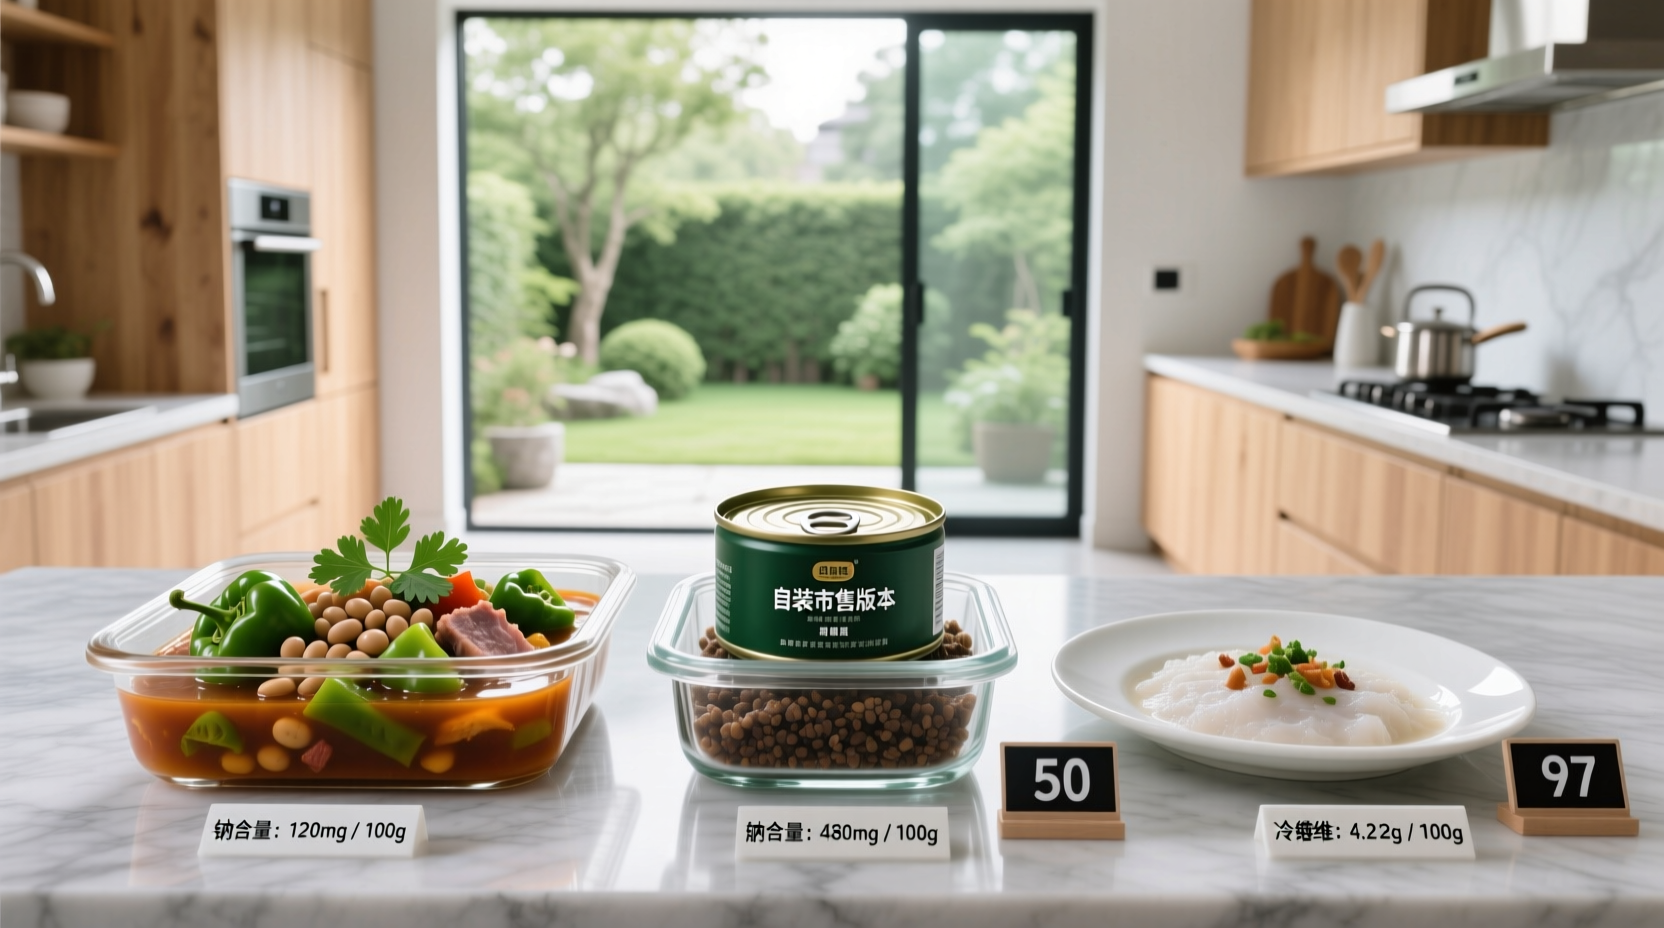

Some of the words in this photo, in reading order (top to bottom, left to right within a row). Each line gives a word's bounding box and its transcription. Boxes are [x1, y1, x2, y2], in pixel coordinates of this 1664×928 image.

[774, 586, 896, 613] 自装市售版本
[1034, 757, 1091, 802] 50
[1541, 754, 1596, 798] 97
[290, 821, 348, 844] 120mg
[350, 821, 361, 841] /
[366, 822, 407, 844] 100g
[883, 823, 892, 843] /
[896, 823, 938, 847] 100g
[1349, 822, 1403, 845] 4.22g
[1407, 822, 1414, 842] /
[1419, 823, 1464, 845] 100g
